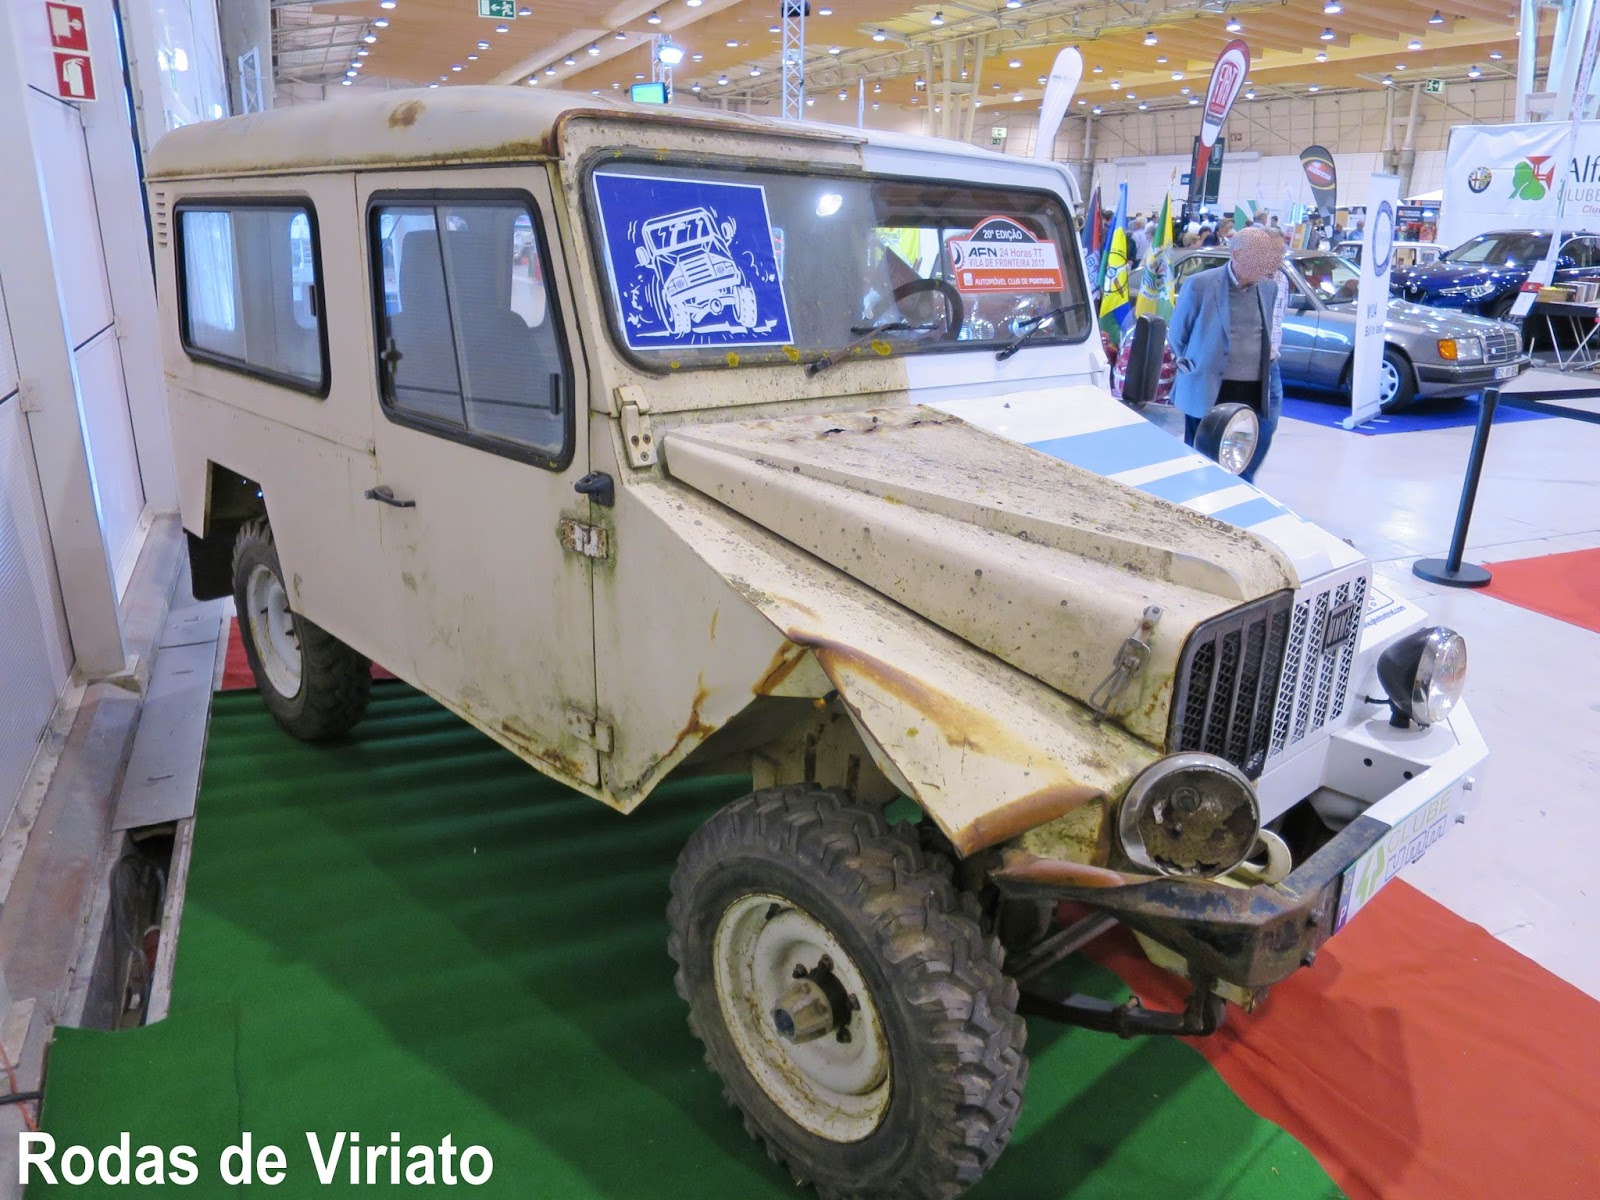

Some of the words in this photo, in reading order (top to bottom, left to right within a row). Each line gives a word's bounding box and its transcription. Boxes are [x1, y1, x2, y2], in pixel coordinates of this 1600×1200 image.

[1212, 63, 1238, 106] FIAT
[1568, 155, 1600, 183] Alf
[995, 228, 1023, 241] EDIÇÃO
[968, 247, 998, 258] AFN
[1000, 248, 1009, 258] 24
[1010, 248, 1032, 258] Horas
[1033, 248, 1043, 258] TT
[968, 258, 984, 267] VILA
[985, 259, 994, 267] DE
[995, 259, 1030, 267] FRONTEIRA
[1031, 259, 1045, 268] 2017
